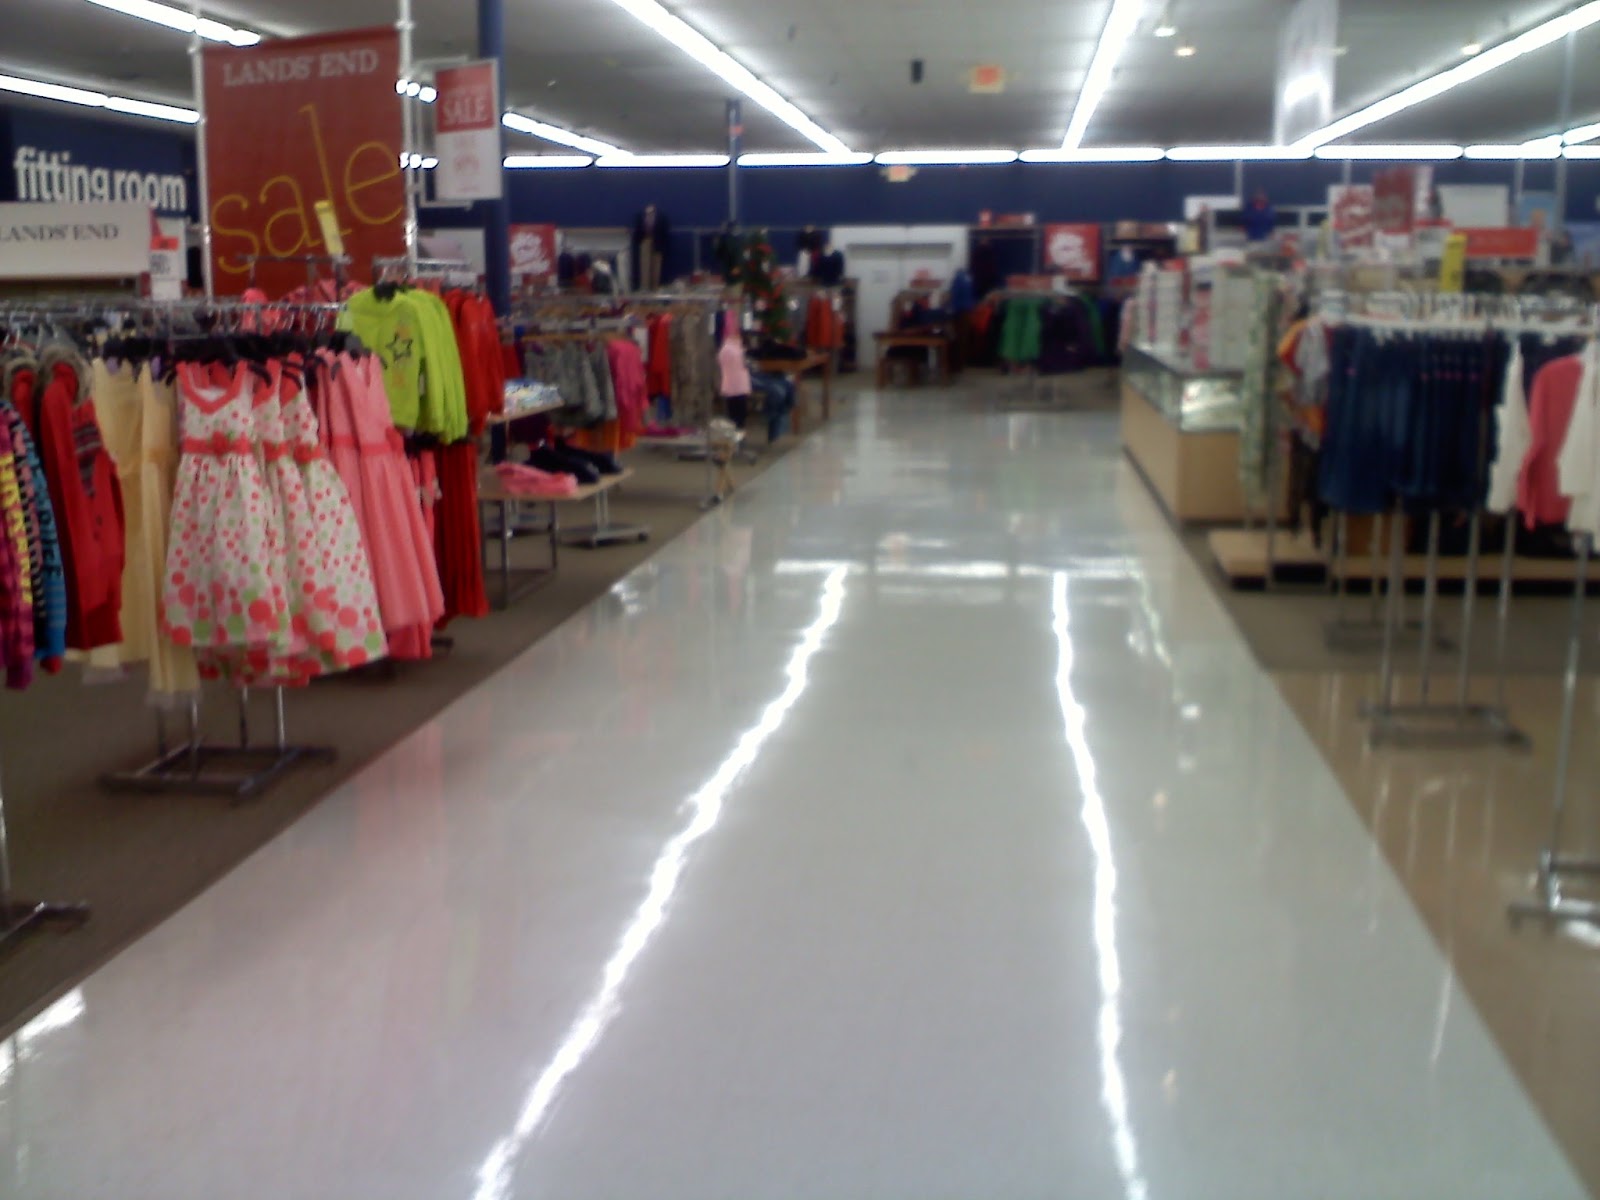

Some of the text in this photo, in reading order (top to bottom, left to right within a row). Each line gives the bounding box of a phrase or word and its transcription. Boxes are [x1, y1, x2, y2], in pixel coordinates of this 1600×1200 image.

[319, 49, 379, 77] END
[442, 95, 489, 125] SALE
[13, 146, 188, 212] fitting room
[211, 102, 404, 274] sale
[73, 223, 120, 241] END
